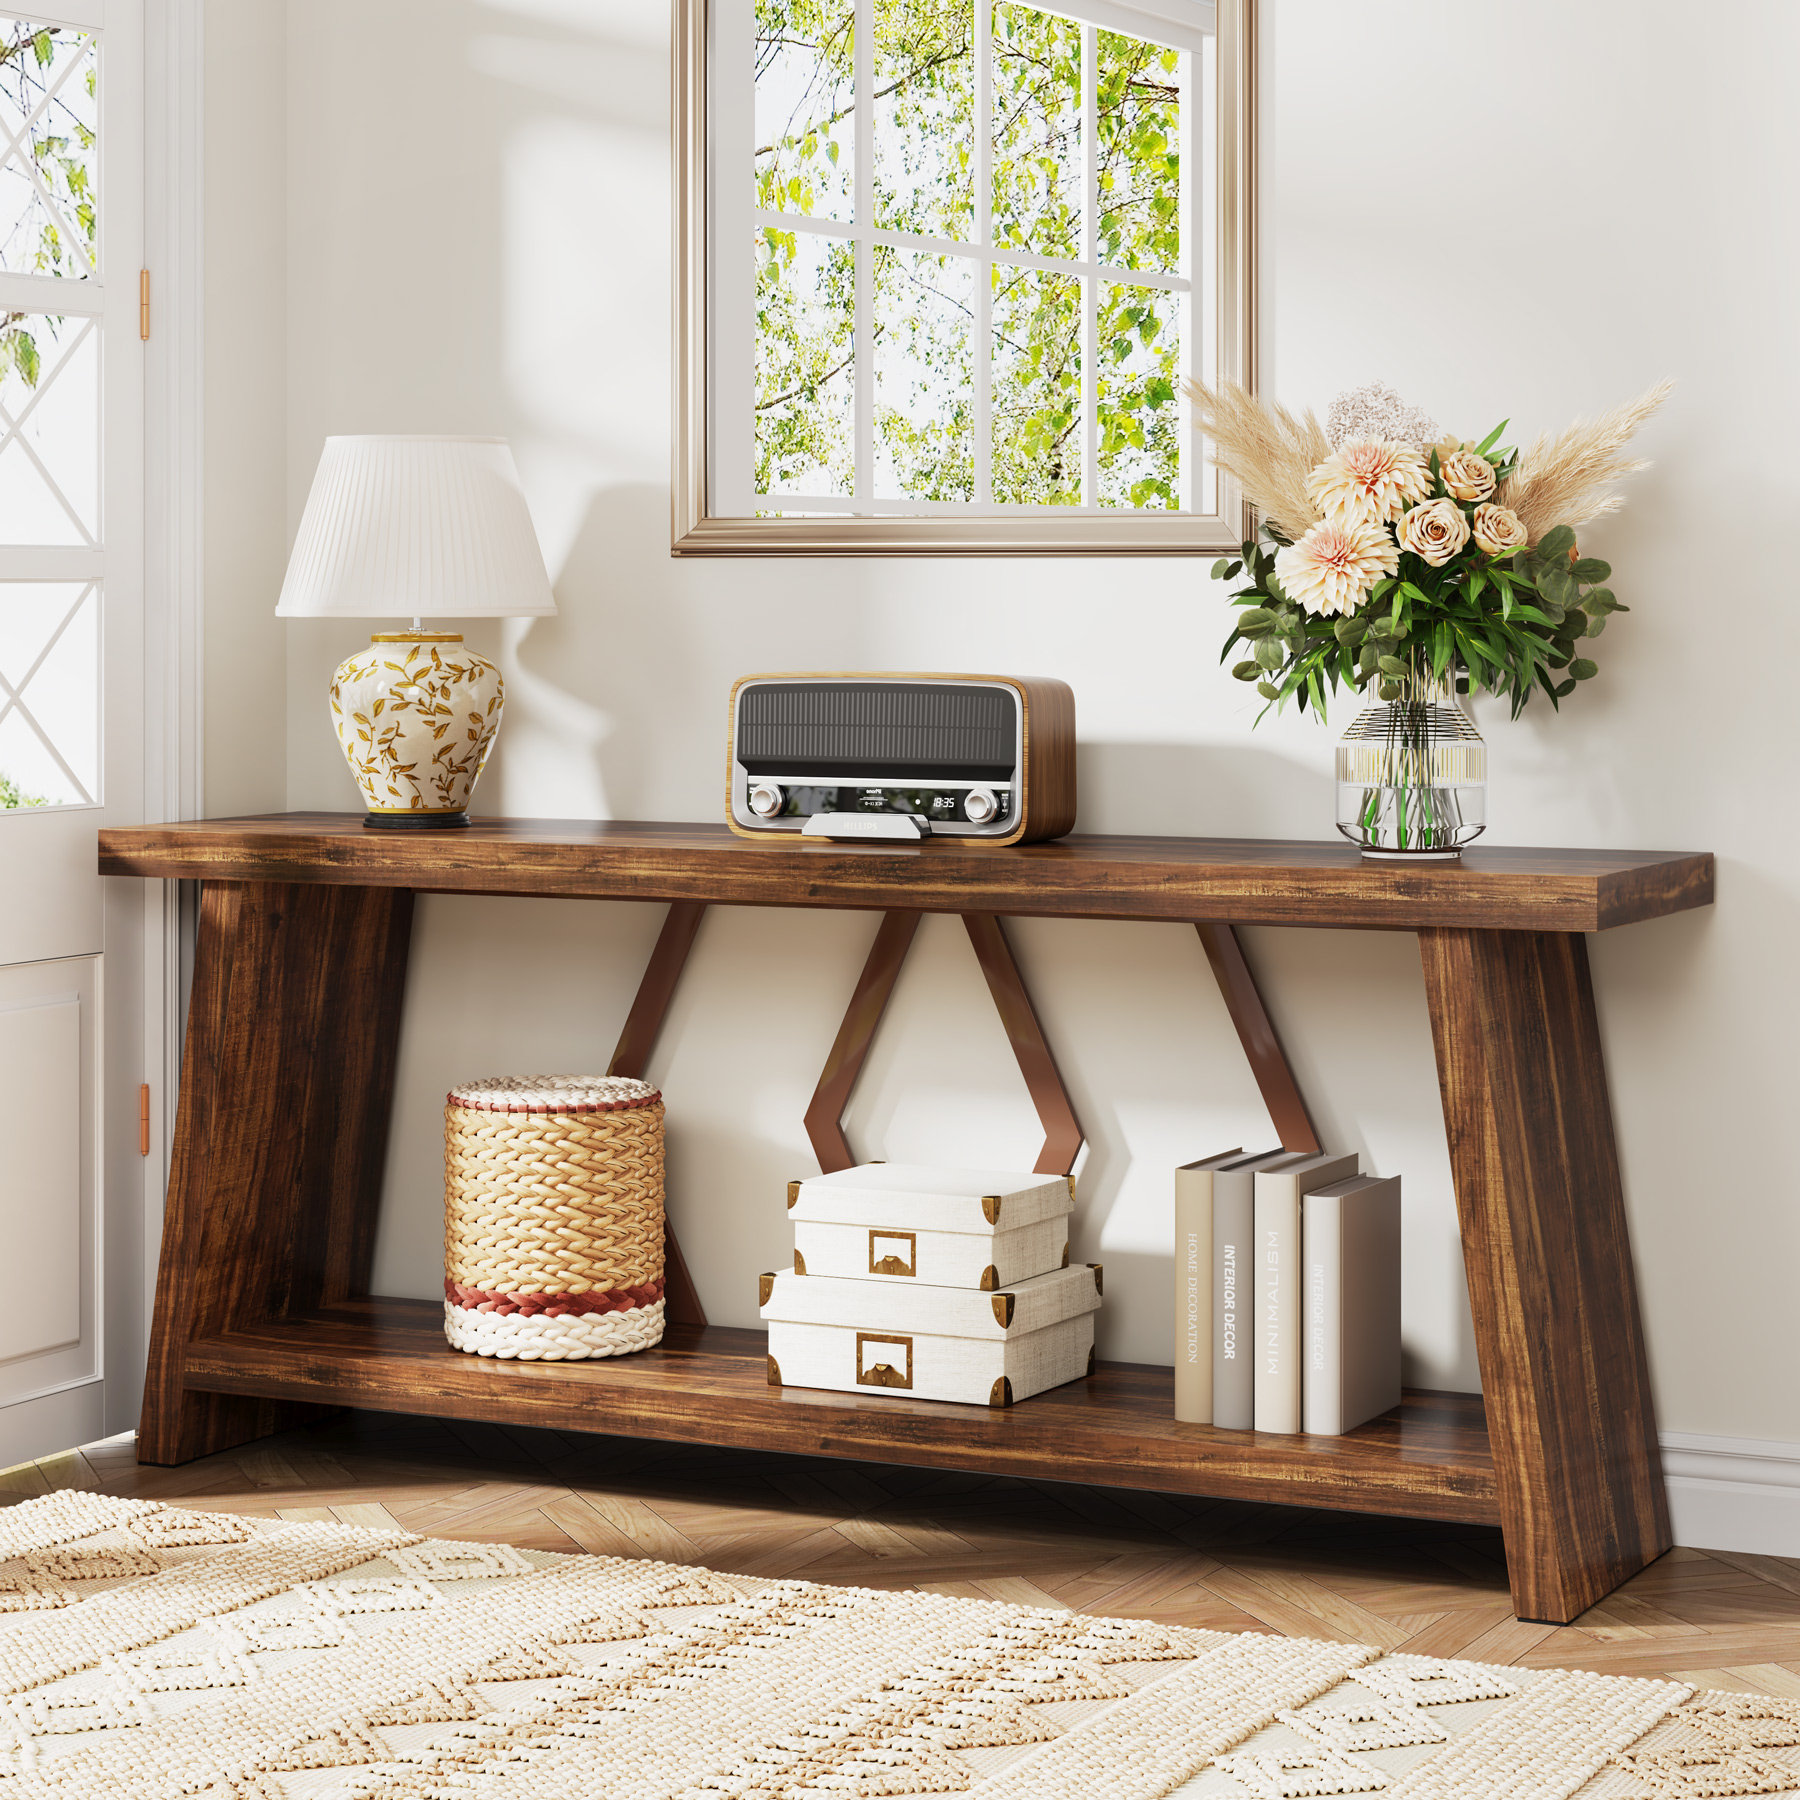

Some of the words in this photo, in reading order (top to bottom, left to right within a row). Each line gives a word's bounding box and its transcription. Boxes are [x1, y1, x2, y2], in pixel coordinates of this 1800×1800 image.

[933, 797, 955, 808] 18:35
[1187, 1232, 1198, 1273] HOME
[1223, 1244, 1236, 1310] INTERIOR
[1187, 1277, 1198, 1364] DECORATION
[1267, 1230, 1279, 1375] MINIMALISM
[1312, 1264, 1324, 1325] INTERIOR
[1223, 1313, 1236, 1360] DECOR
[1312, 1327, 1324, 1371] DECOR
